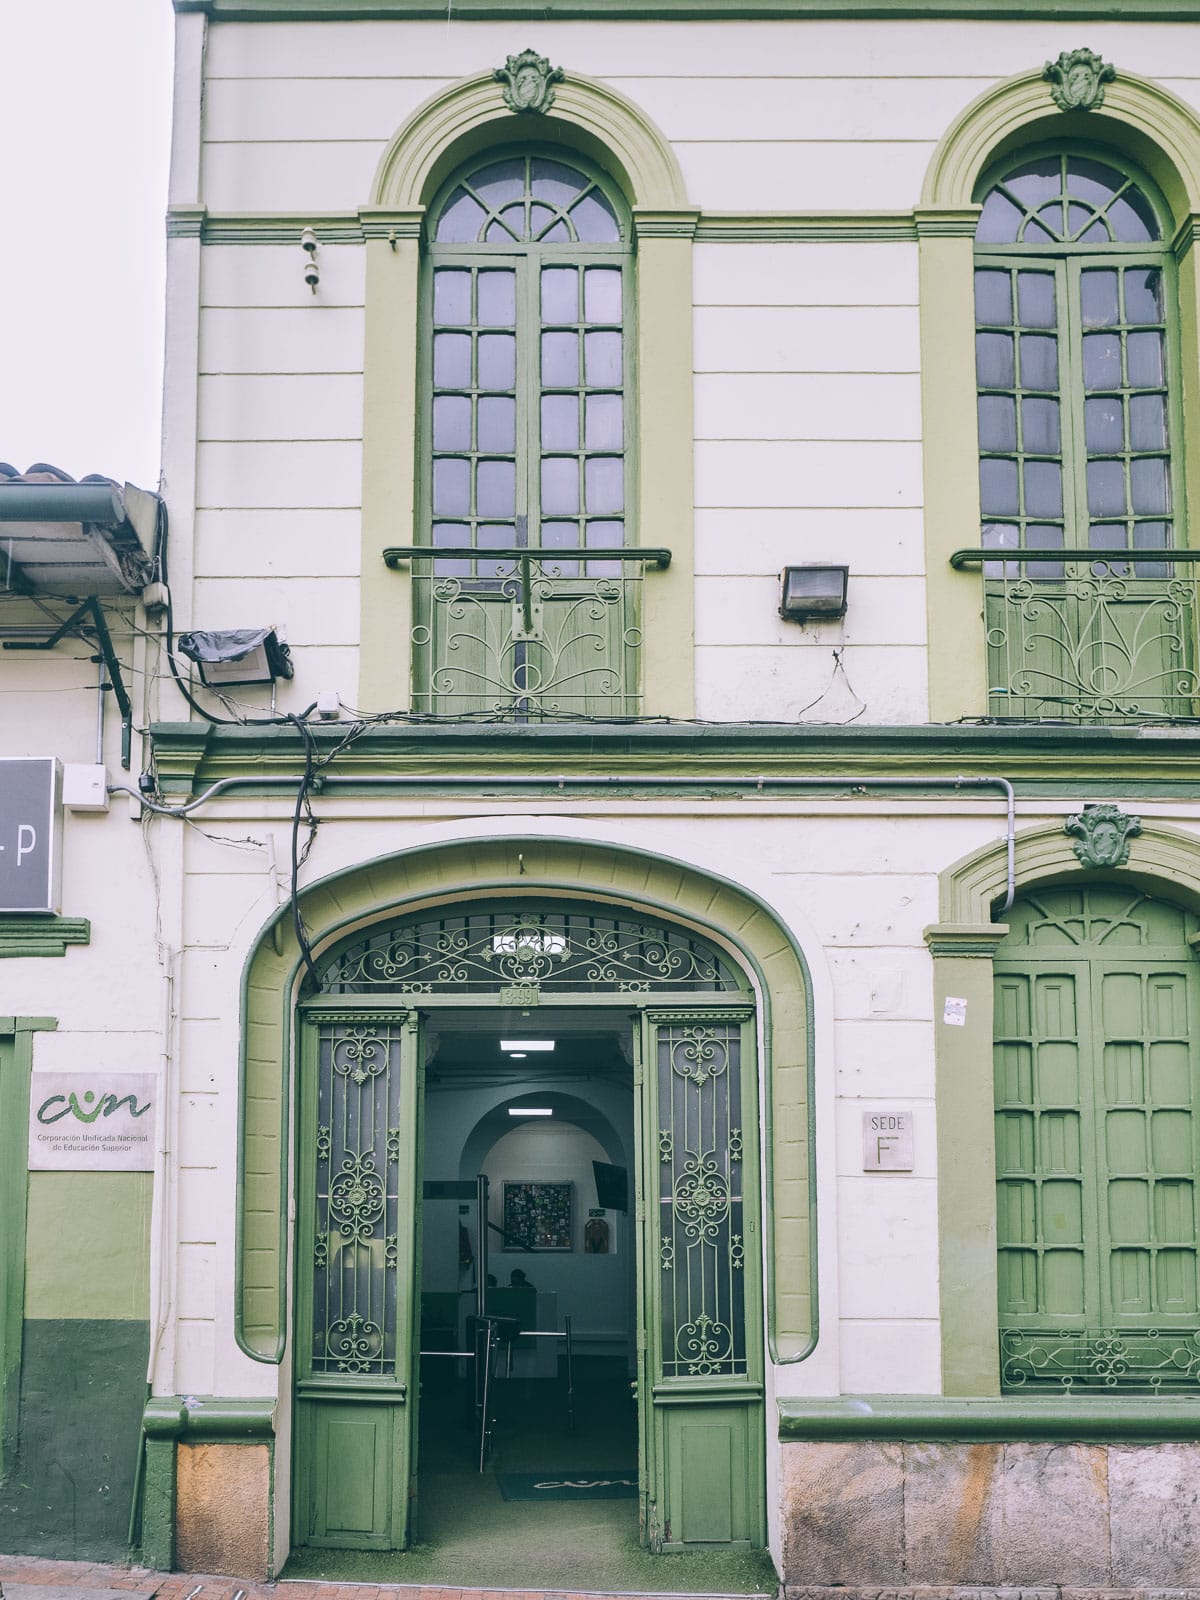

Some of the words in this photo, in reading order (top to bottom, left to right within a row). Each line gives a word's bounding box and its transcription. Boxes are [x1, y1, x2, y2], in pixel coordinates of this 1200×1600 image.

[17, 824, 36, 867] P
[871, 1116, 905, 1131] SEDE
[82, 1134, 116, 1142] Unificada
[118, 1134, 148, 1142] Nacional
[101, 1144, 132, 1152] Superior
[877, 1136, 899, 1165] F
